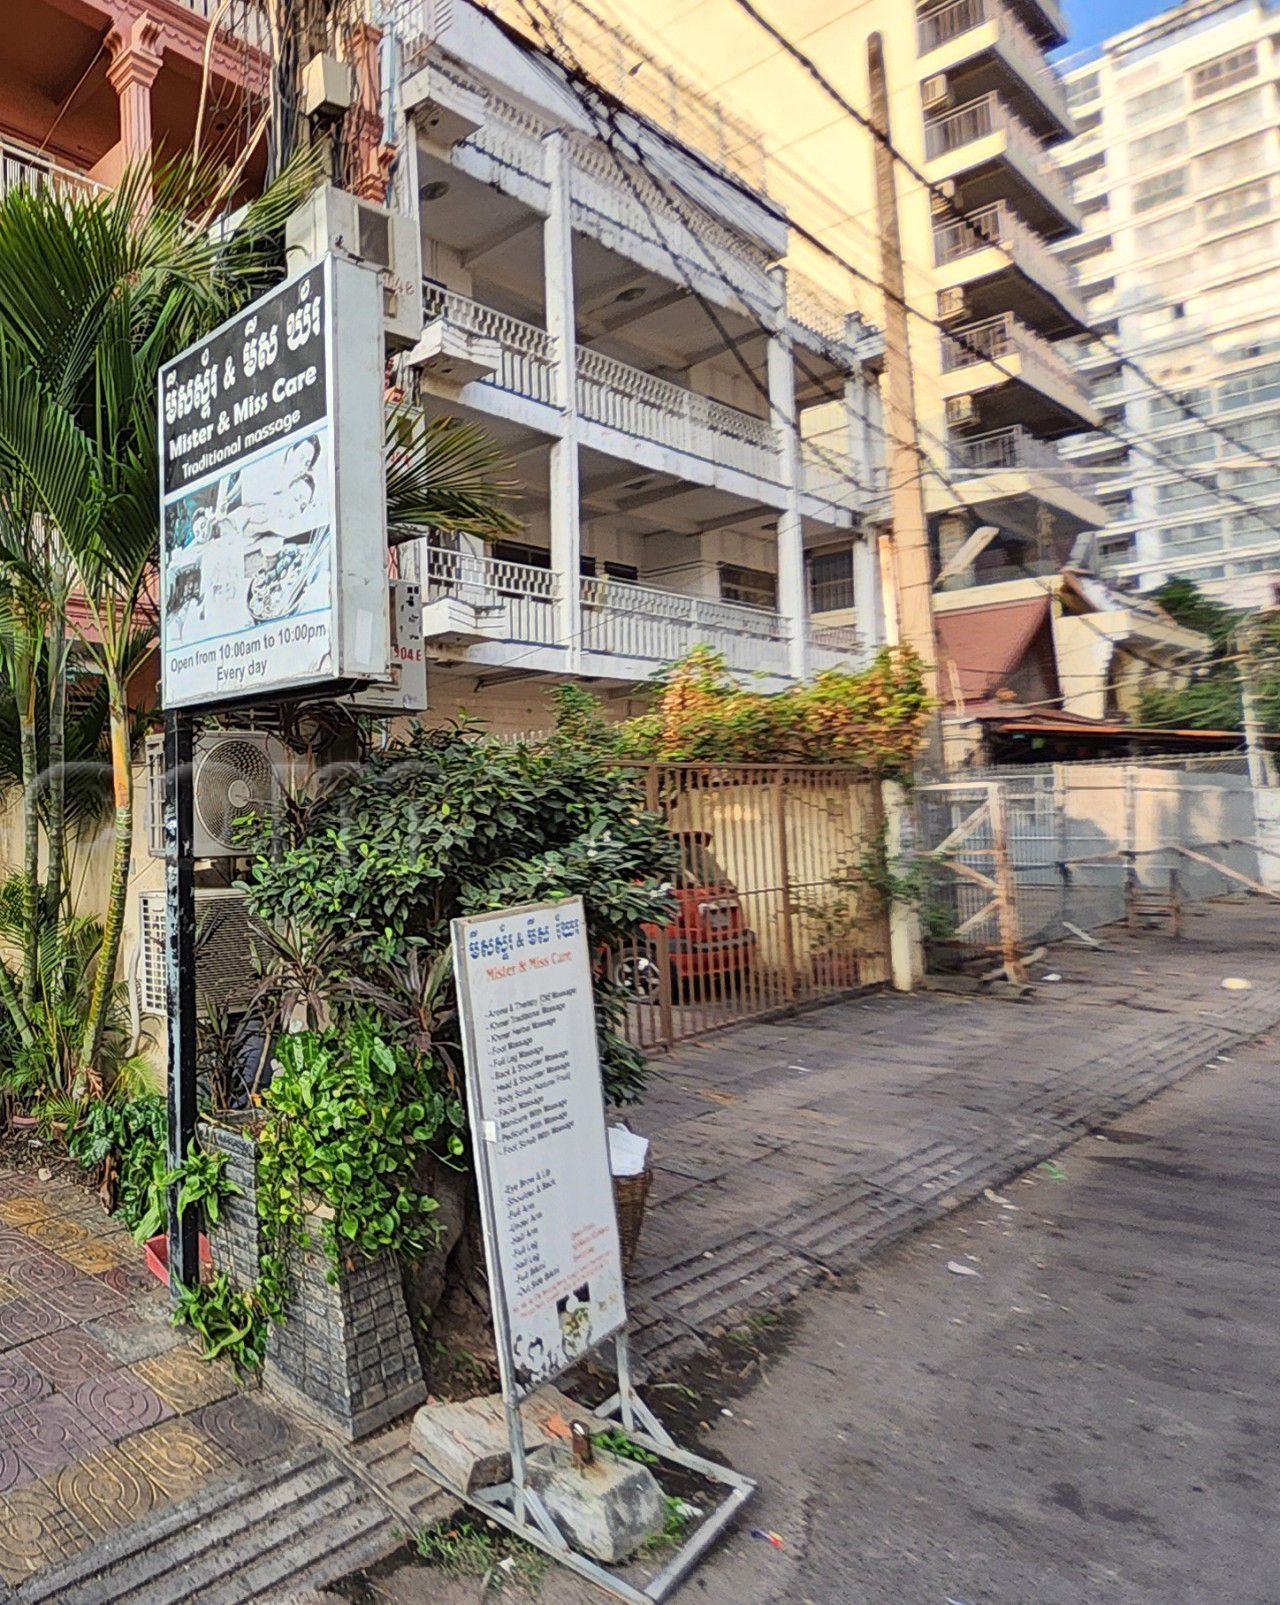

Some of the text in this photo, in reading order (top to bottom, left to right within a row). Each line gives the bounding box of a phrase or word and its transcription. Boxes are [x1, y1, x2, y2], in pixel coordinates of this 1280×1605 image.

[223, 355, 236, 391] &
[169, 366, 318, 461] Mister & Miss Care
[182, 409, 301, 479] Traditional massage
[170, 656, 194, 673] Open
[195, 650, 216, 665] from
[264, 635, 275, 650] to
[278, 623, 326, 645] 10:00pm
[216, 659, 268, 683] Every day
[486, 950, 573, 981] Mister & Miss Care
